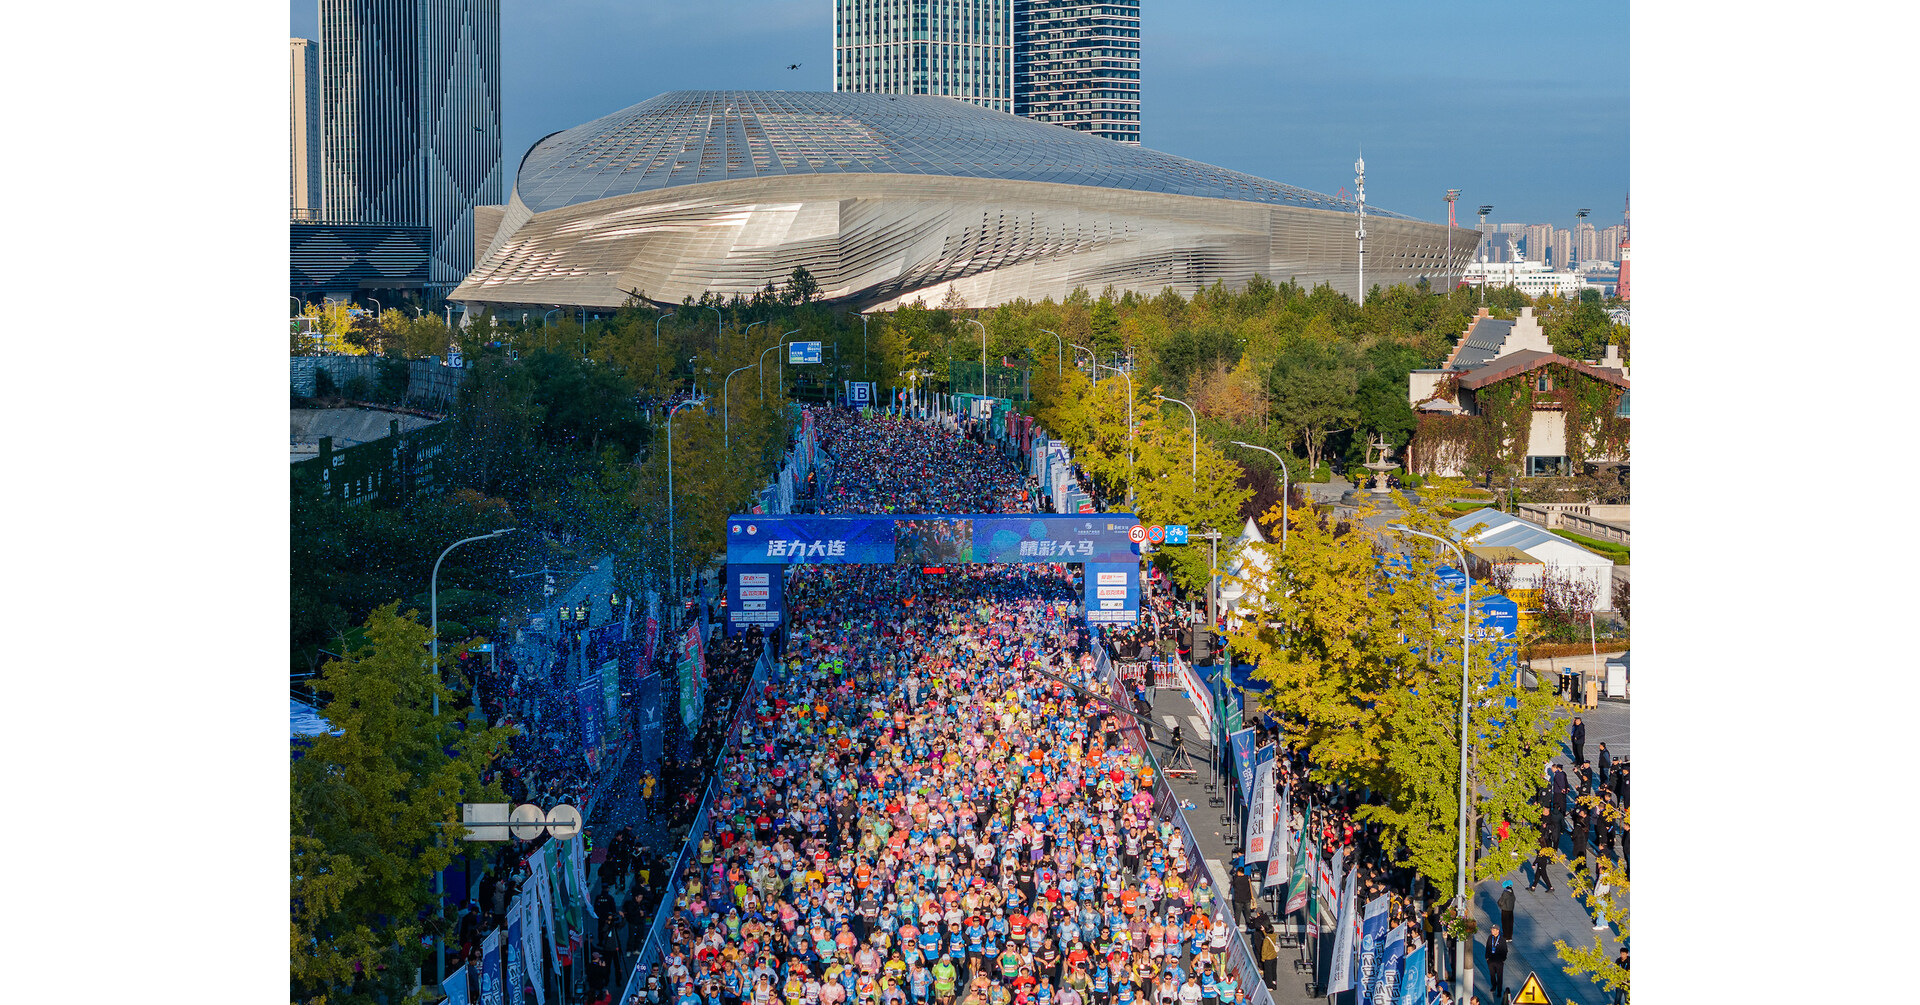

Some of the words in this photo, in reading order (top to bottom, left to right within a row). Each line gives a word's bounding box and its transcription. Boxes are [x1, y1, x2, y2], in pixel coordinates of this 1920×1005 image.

[453, 356, 461, 367] C
[857, 387, 867, 399] B
[1132, 529, 1144, 539] 60
[766, 539, 846, 557] 活力大连
[1019, 540, 1094, 556] 精彩大马
